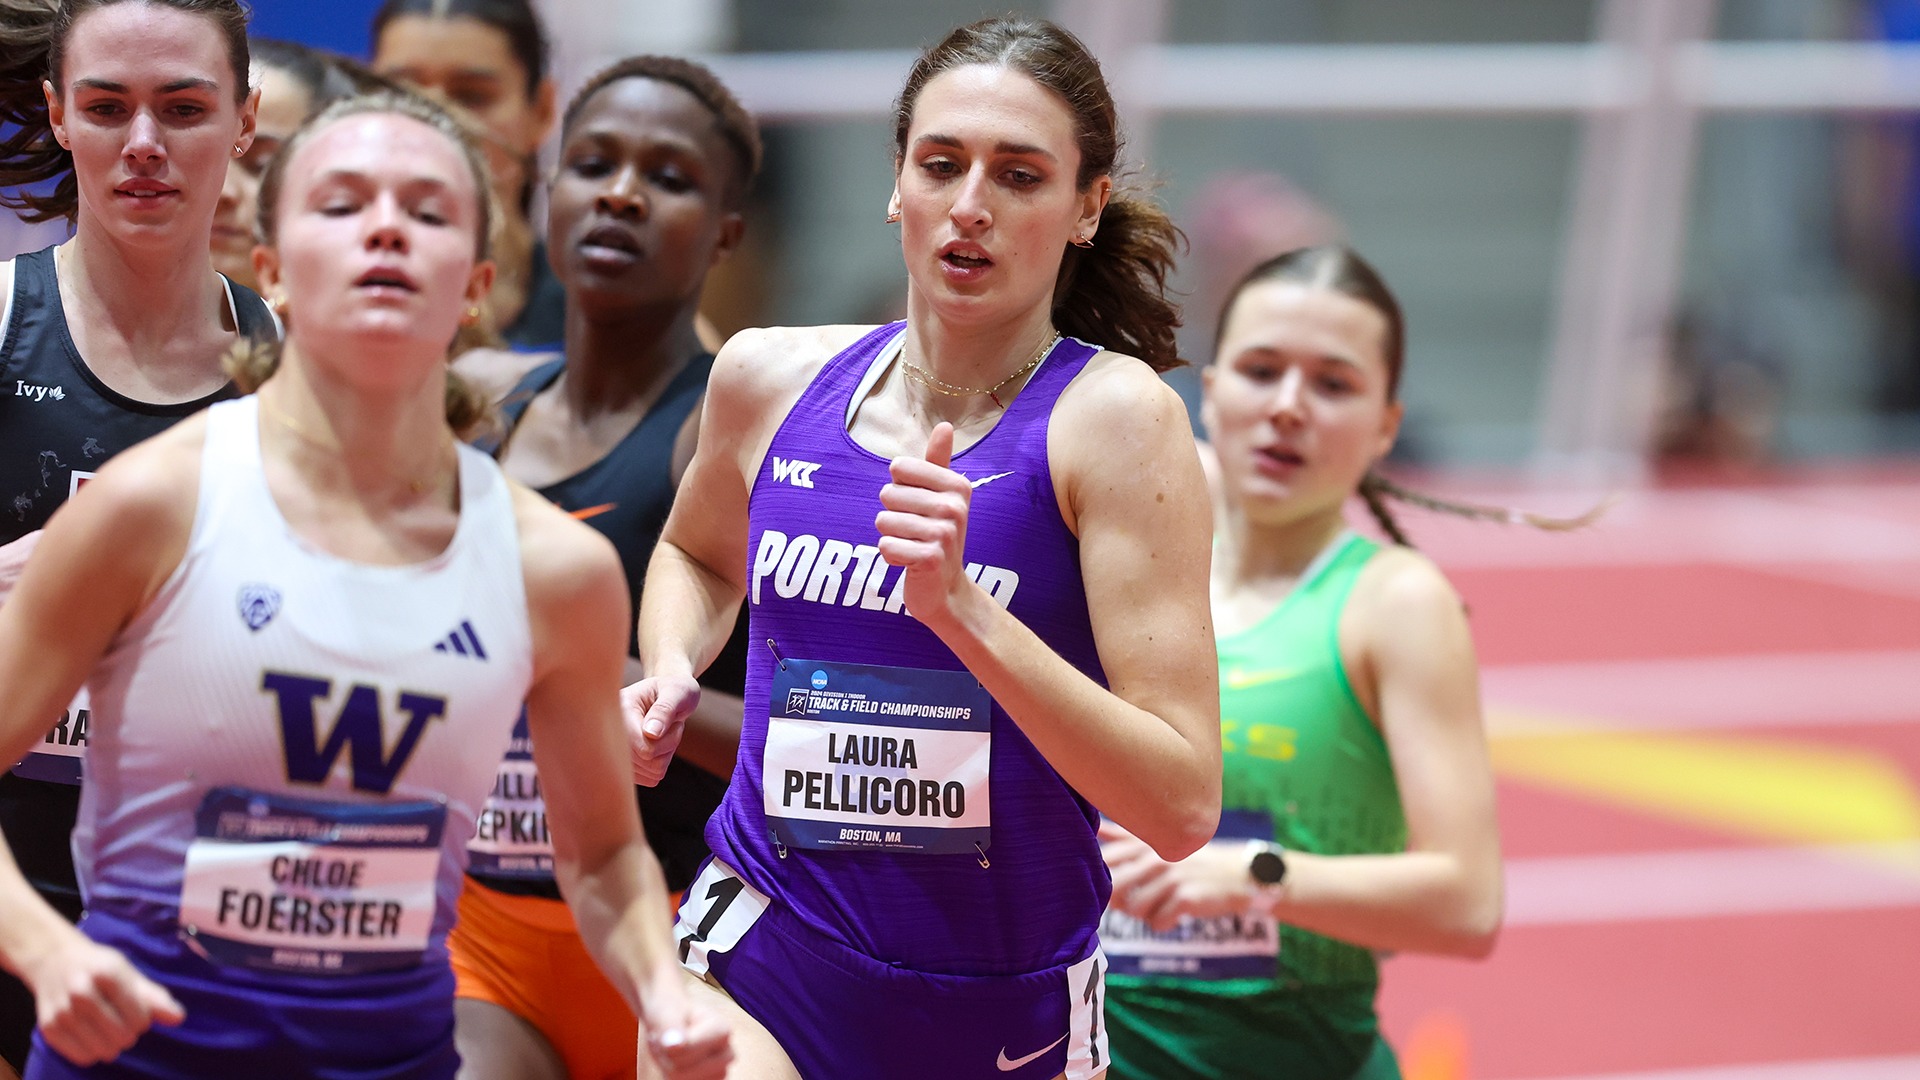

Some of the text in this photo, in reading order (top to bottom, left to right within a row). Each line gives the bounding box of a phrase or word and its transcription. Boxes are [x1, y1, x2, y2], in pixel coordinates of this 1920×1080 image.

[15, 380, 48, 402] Ivy
[772, 456, 822, 489] WCC
[752, 529, 1020, 617] PORTLD
[808, 696, 971, 720] TRACK & FIELD CHAMPIONSHIPS
[262, 670, 446, 794] W
[828, 733, 918, 769] LAURA
[782, 769, 966, 819] PELLICORO
[839, 828, 901, 843] BOSTON, MA
[271, 856, 366, 889] CHLOE
[217, 888, 404, 937] FOERSTER
[678, 876, 745, 965] 1
[1083, 958, 1100, 1070] 1
